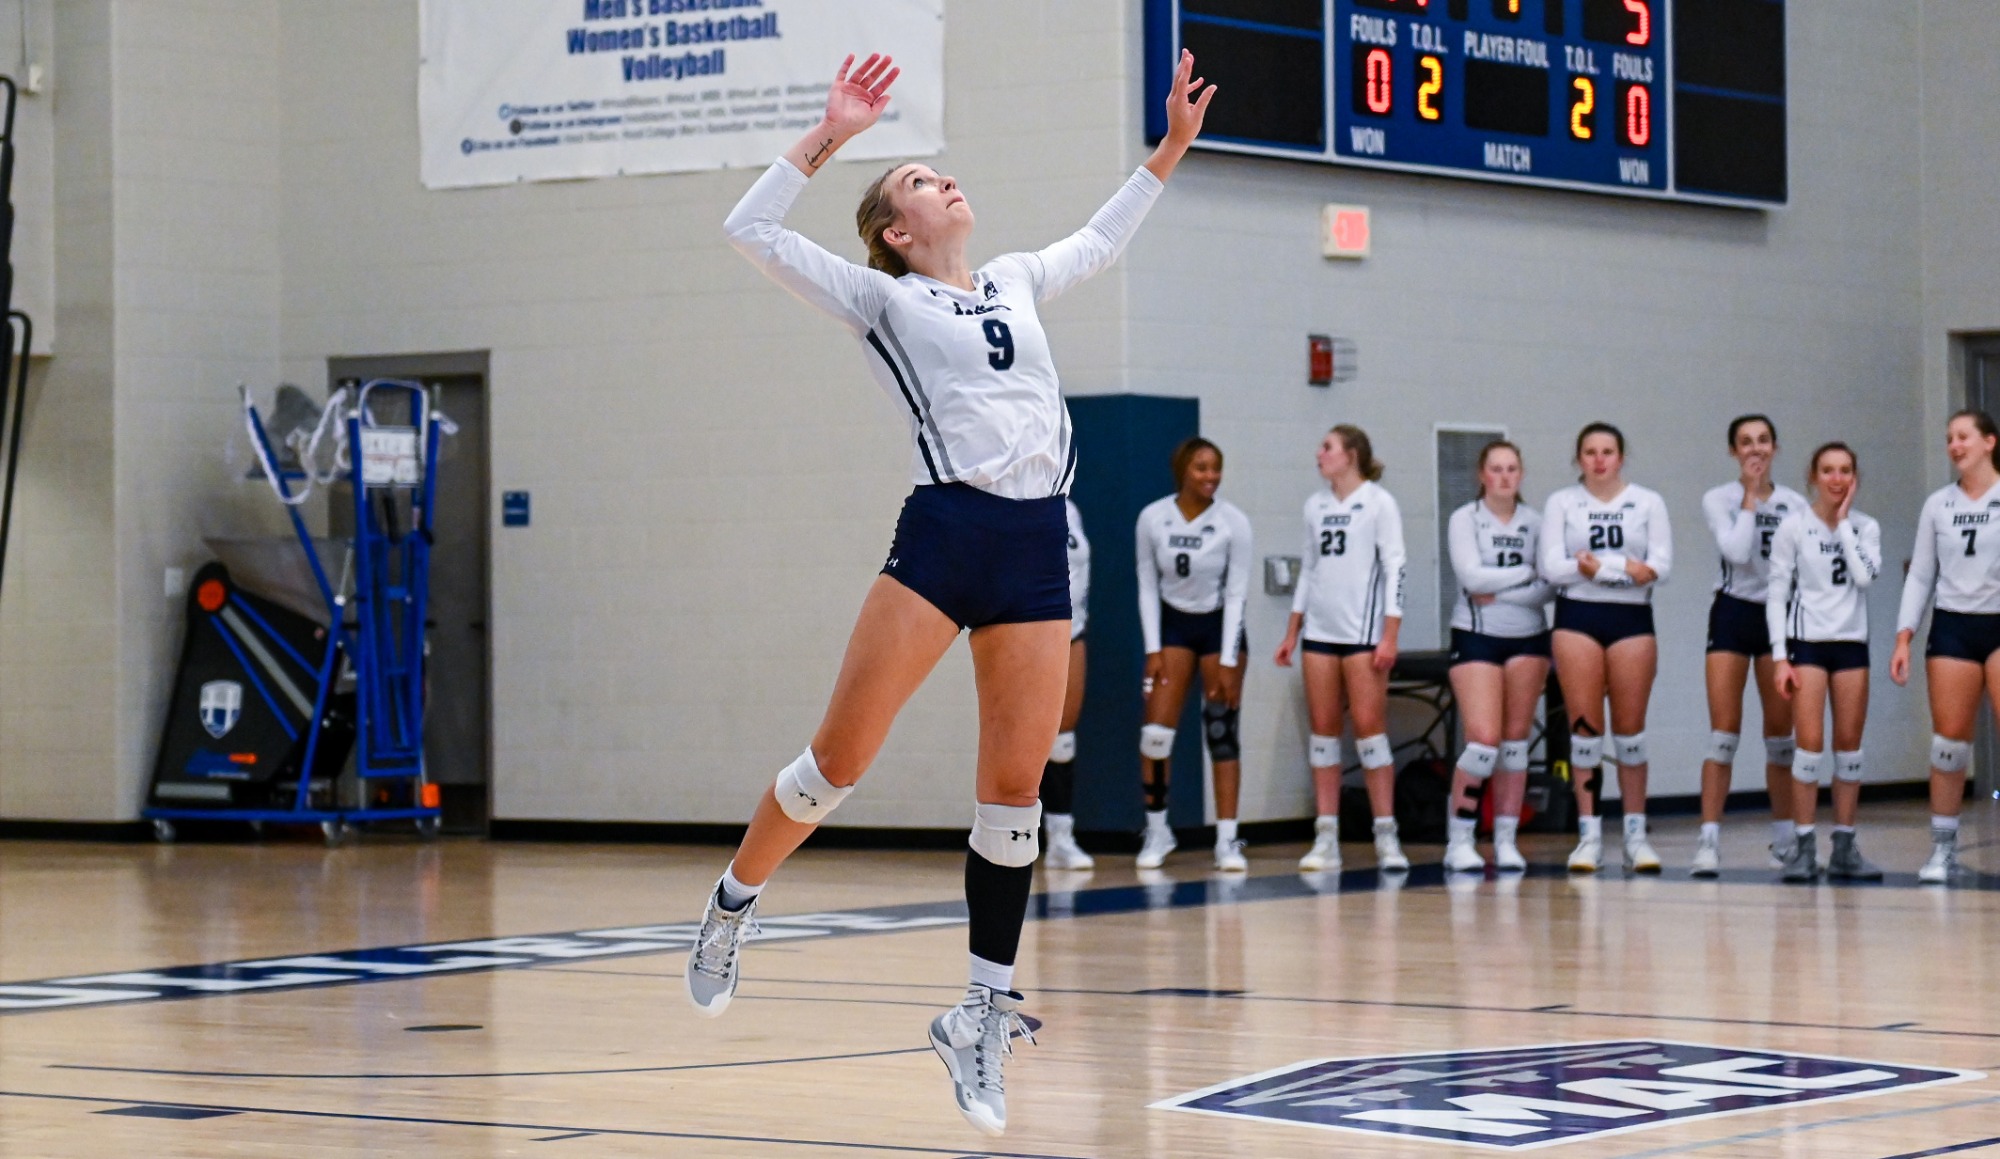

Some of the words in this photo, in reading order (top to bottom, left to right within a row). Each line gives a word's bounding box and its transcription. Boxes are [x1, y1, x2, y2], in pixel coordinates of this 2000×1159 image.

[584, 0, 642, 20] Mens
[567, 24, 660, 54] Women's
[1350, 13, 1397, 46] FOULS
[1410, 23, 1449, 54] T.O.L.
[1464, 30, 1515, 63] PLAYER
[1516, 37, 1551, 68] FOUL
[1564, 44, 1600, 75] T.O.L.
[622, 48, 725, 82] Volleyball
[1613, 52, 1653, 82] FOULS
[1367, 48, 1392, 114] 0
[1417, 55, 1443, 120] 2
[1571, 76, 1595, 140] 2
[1627, 84, 1650, 146] 0
[1350, 125, 1386, 156] WON
[1483, 141, 1532, 172] MATCH
[1619, 157, 1650, 185] WON
[982, 319, 1015, 371] 9
[1320, 529, 1346, 557] 23
[1589, 524, 1624, 550] 20
[1761, 530, 1775, 560] 5
[1961, 529, 1977, 556] 7
[1176, 552, 1190, 578] 8
[1832, 556, 1847, 585] 2
[1342, 1056, 1900, 1137] MAC
